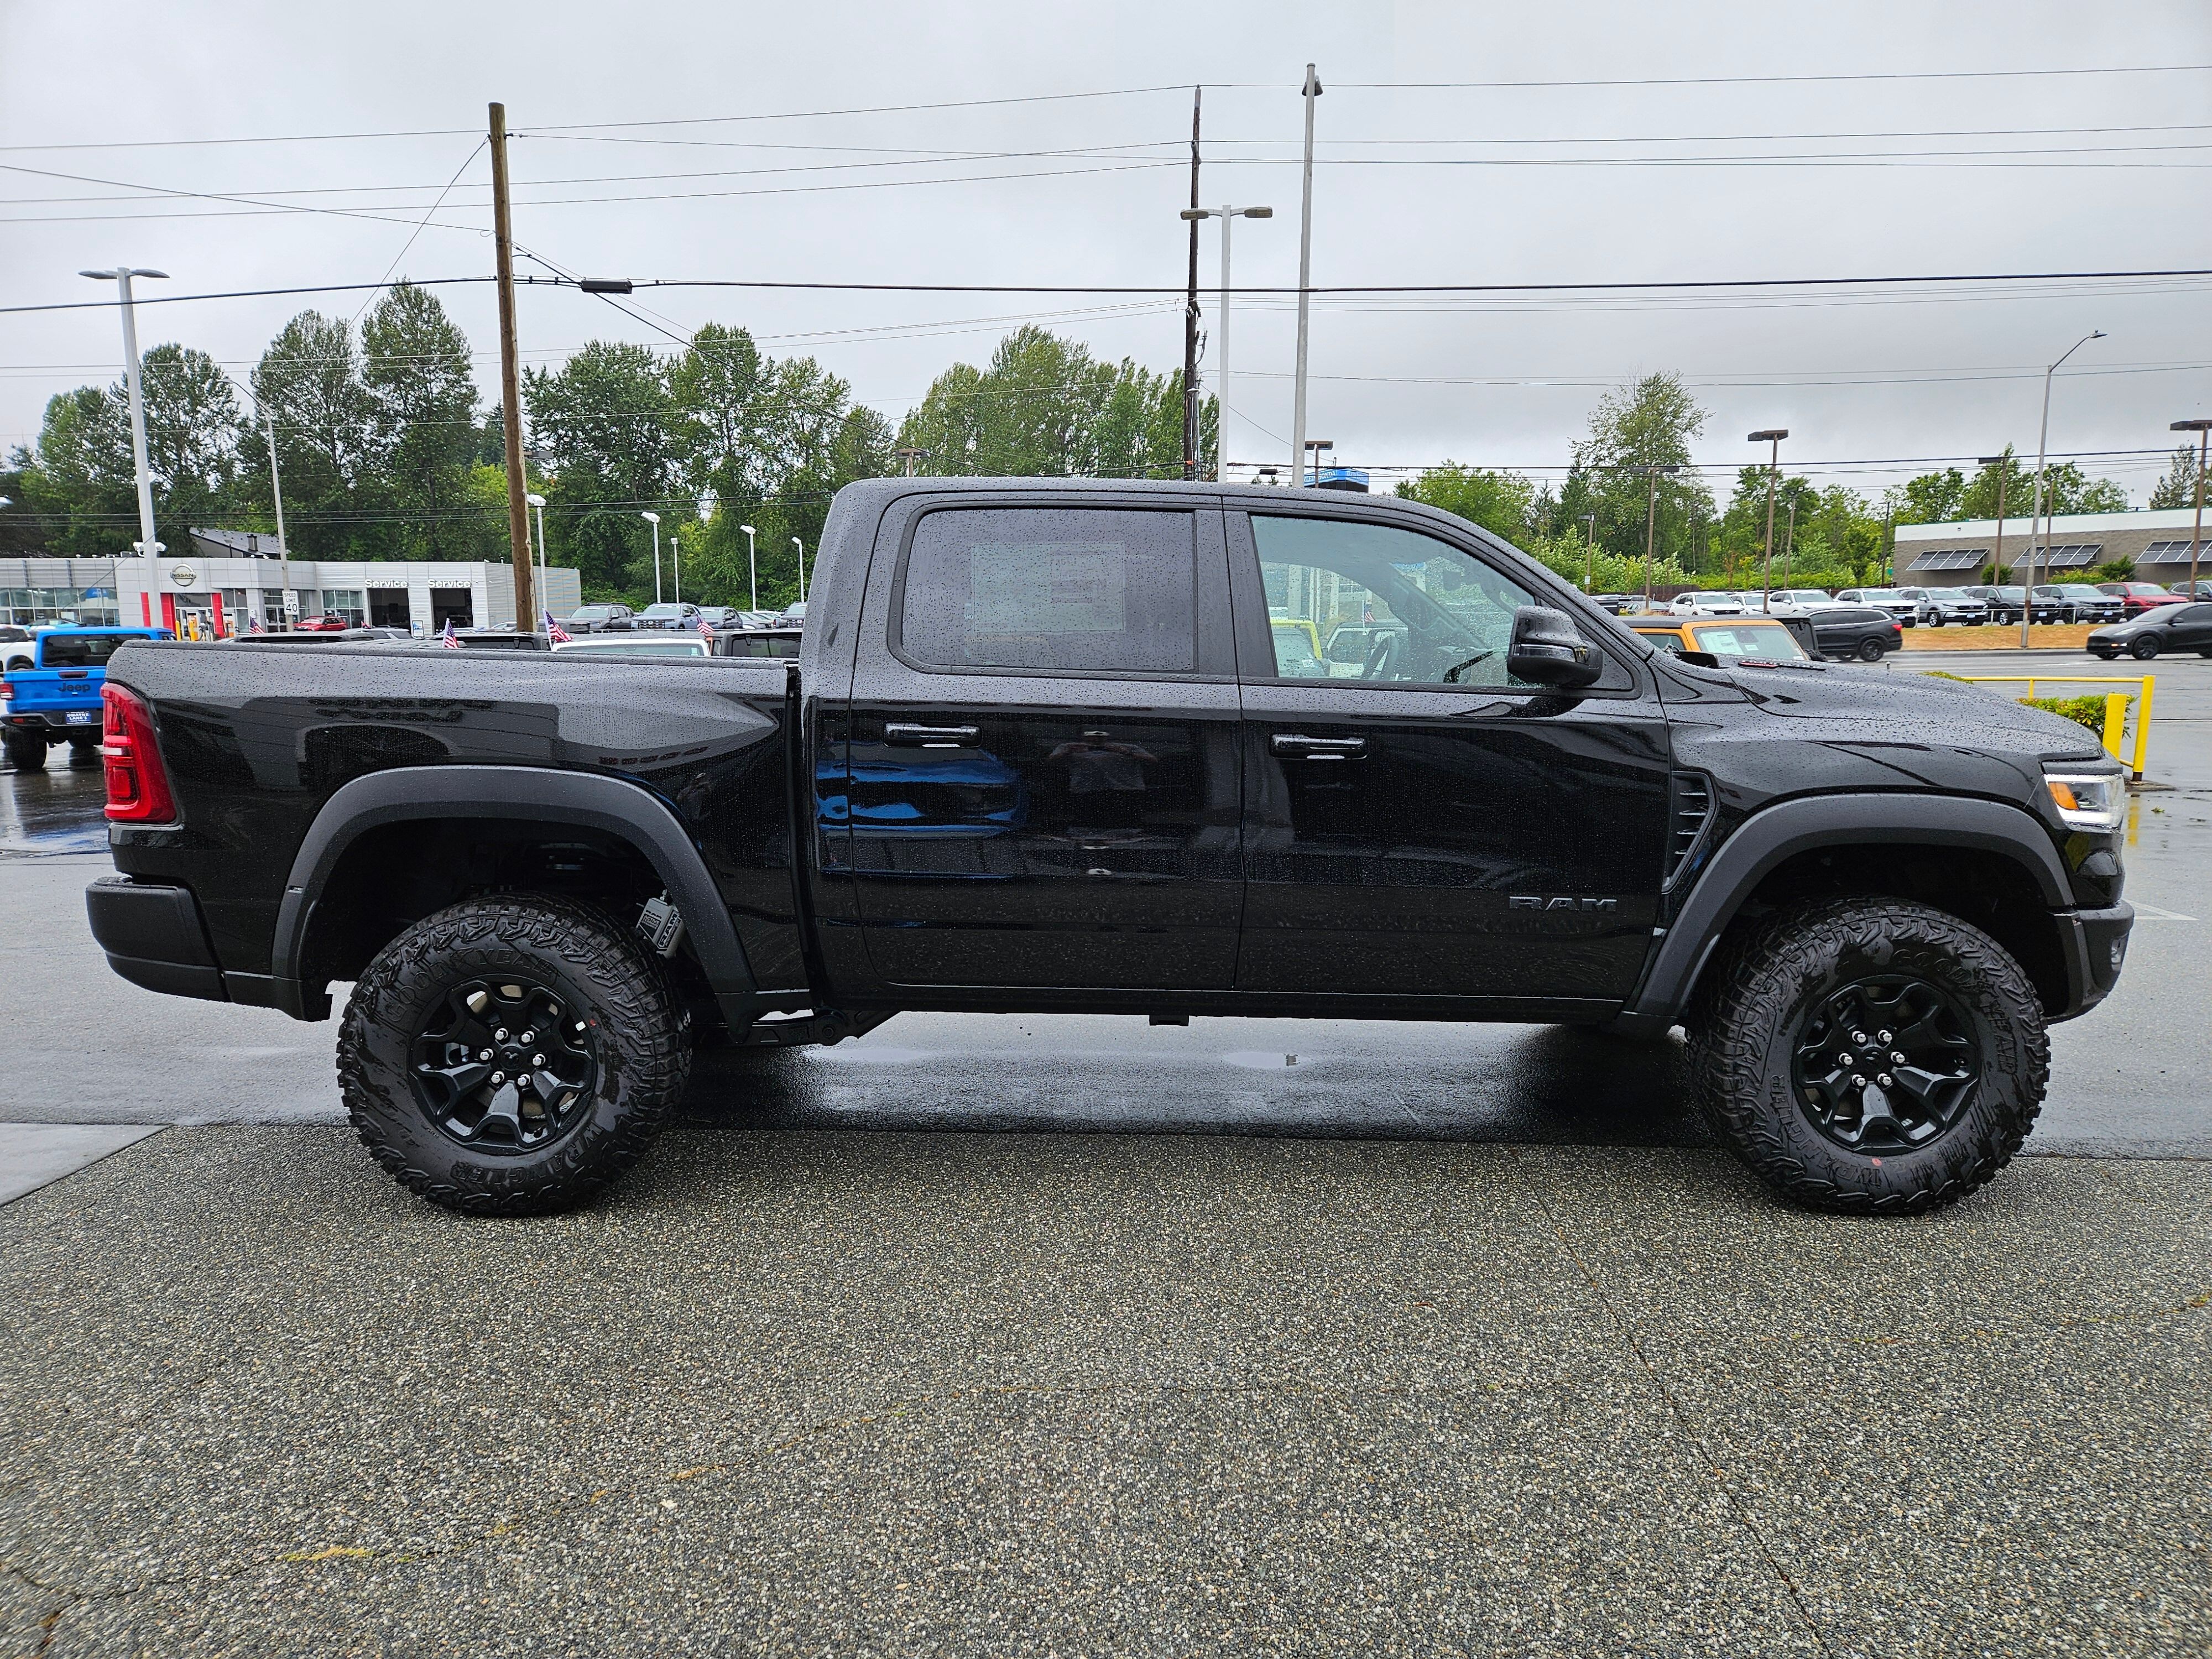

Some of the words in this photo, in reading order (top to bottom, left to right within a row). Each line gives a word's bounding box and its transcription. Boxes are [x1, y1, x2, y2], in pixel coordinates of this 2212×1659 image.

[365, 579, 408, 588] Service
[428, 579, 471, 588] Service
[286, 603, 298, 612] 40
[58, 682, 91, 693] Jeep
[1509, 896, 1618, 911] RAM
[659, 914, 677, 946] RAM
